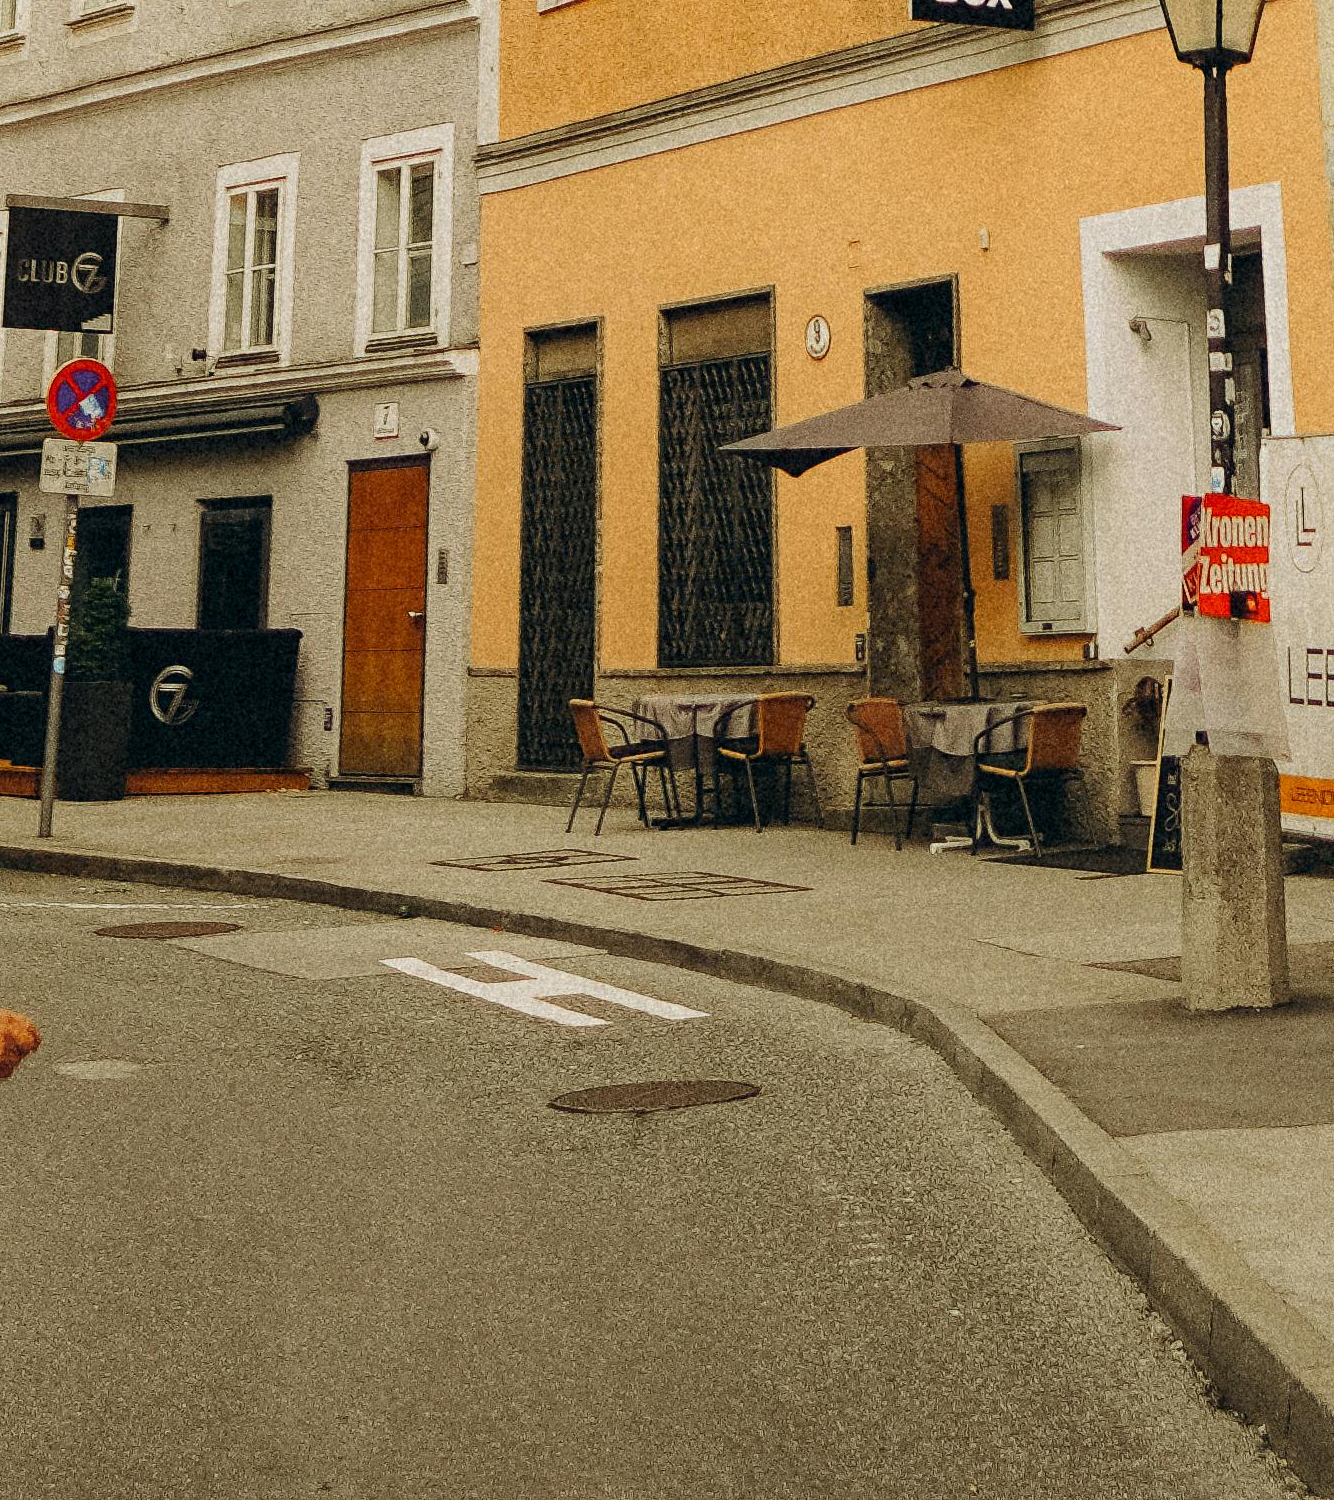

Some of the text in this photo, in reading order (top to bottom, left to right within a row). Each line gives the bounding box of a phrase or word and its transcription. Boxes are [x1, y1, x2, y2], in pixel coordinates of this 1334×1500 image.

[18, 258, 68, 284] CLUB
[813, 319, 821, 345] 9
[1202, 508, 1270, 549] Kronen
[1198, 552, 1270, 600] Zeitung
